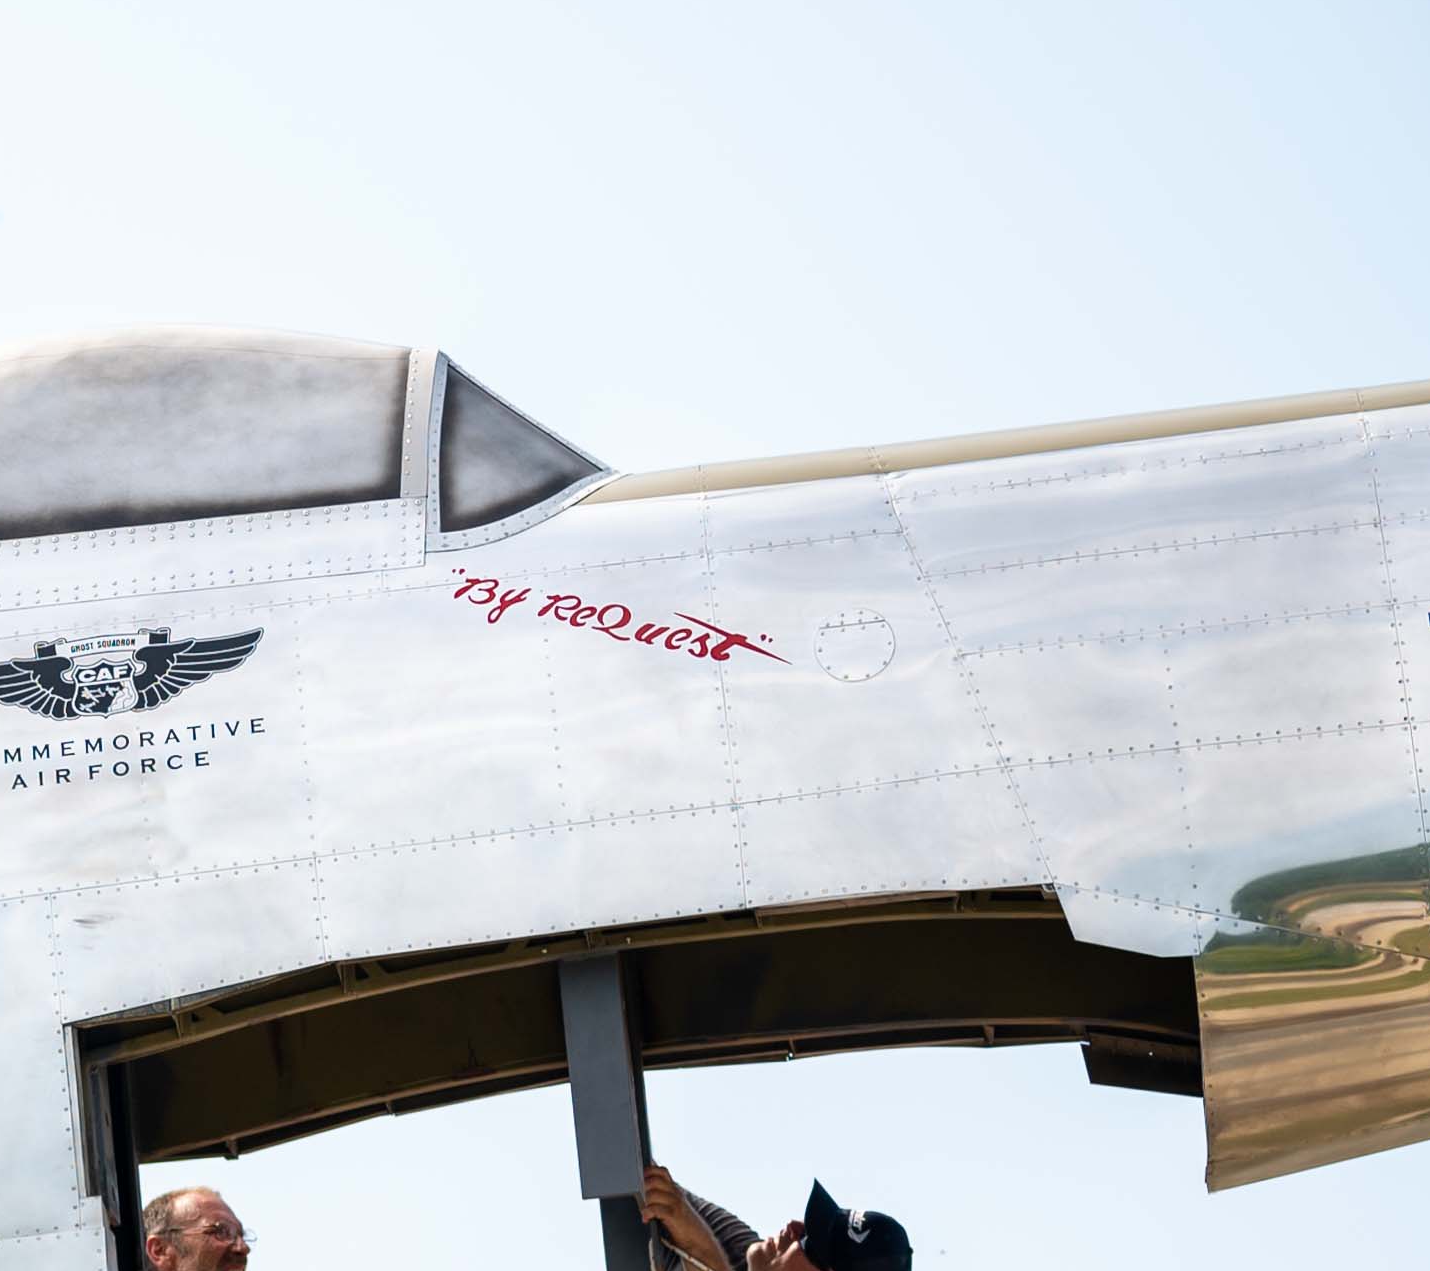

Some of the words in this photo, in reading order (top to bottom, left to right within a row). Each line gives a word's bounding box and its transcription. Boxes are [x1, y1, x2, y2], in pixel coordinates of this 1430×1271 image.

[70, 642, 94, 653] GHOST
[97, 638, 136, 649] SQUADRON
[78, 665, 129, 683] CAF
[11, 768, 71, 790] AIR
[89, 750, 210, 780] FORCE
